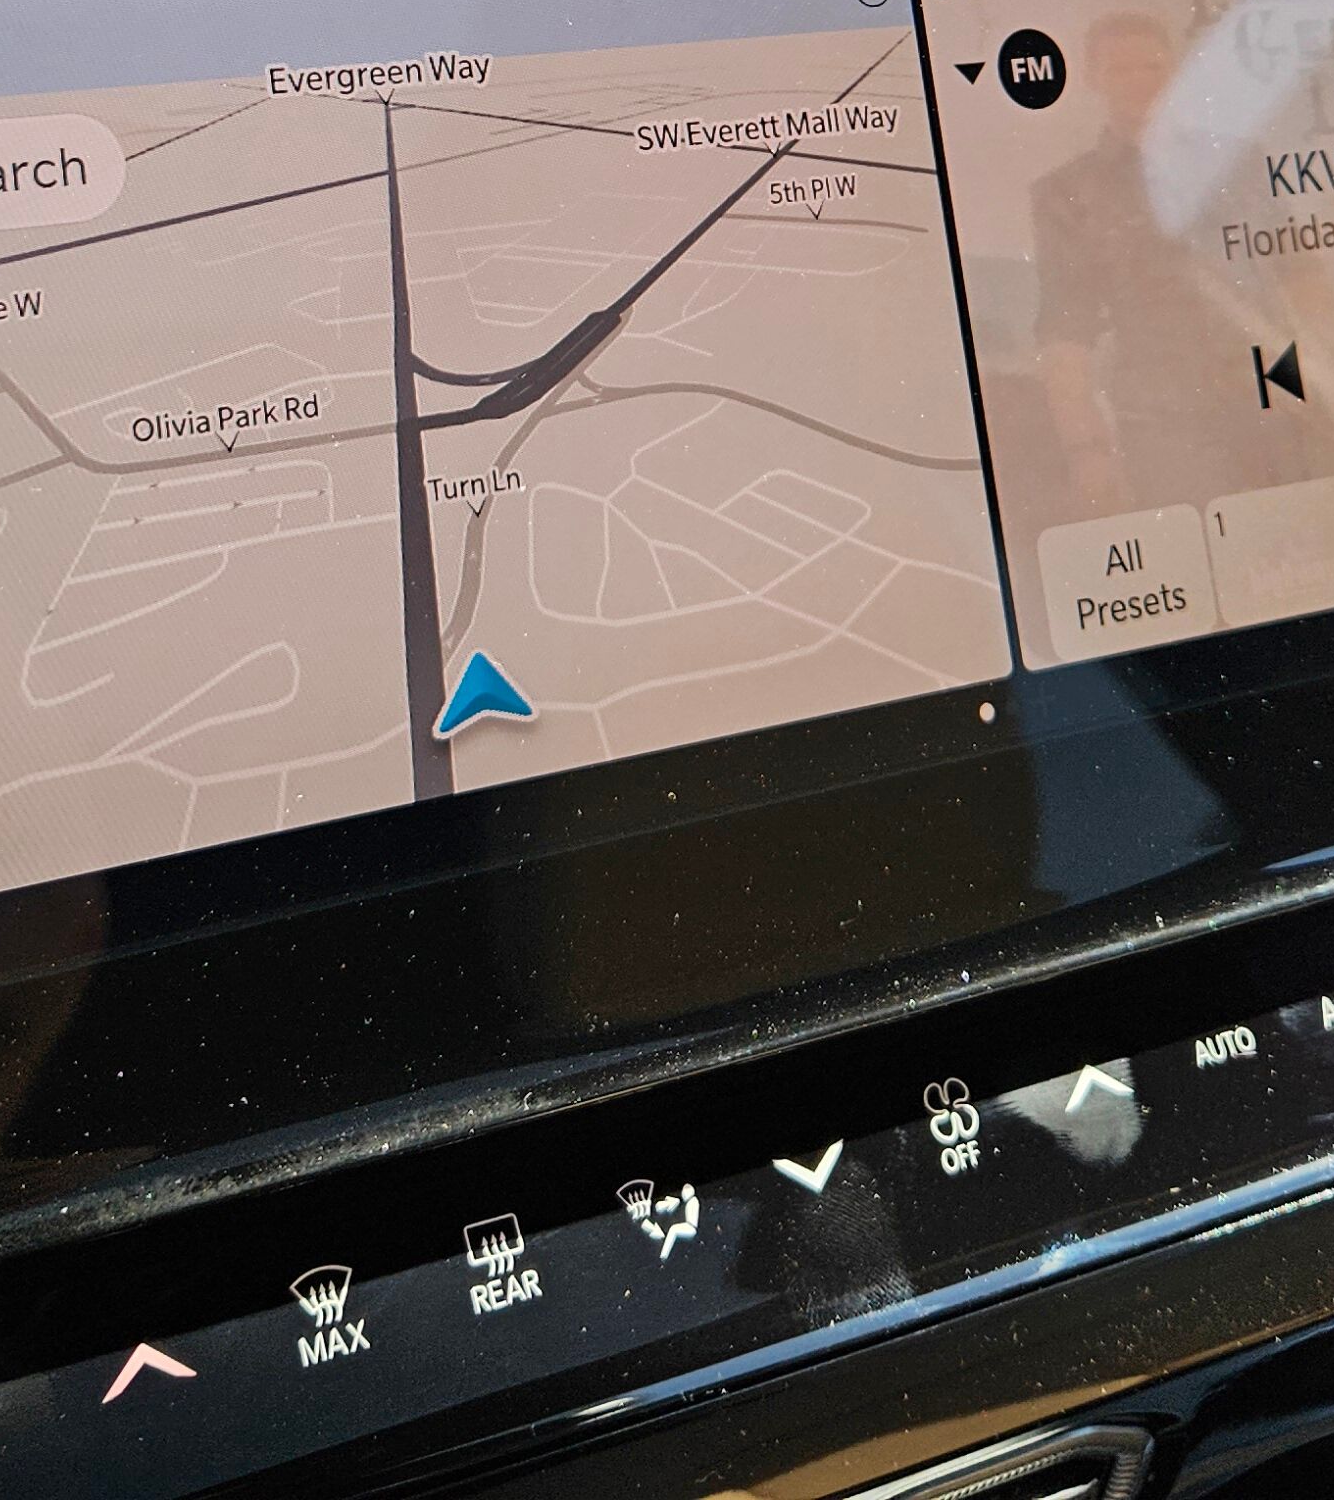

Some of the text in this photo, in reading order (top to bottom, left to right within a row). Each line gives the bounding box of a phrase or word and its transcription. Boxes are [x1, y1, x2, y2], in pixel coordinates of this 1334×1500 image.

[269, 54, 490, 96] Evergreen Way
[1011, 55, 1053, 83] FM
[637, 106, 898, 151] SW Everett Mall Way
[770, 176, 857, 205] 5th Pl W
[13, 292, 43, 317] W
[132, 394, 319, 443] Olivia Park Rd
[429, 468, 521, 502] Turn Ln
[1214, 511, 1225, 538] 1
[1105, 539, 1143, 576] All
[1076, 586, 1187, 629] Presets
[1195, 1026, 1257, 1069] AUTO
[940, 1140, 981, 1176] OFF
[470, 1269, 543, 1315] REAR
[297, 1319, 371, 1368] MAX
